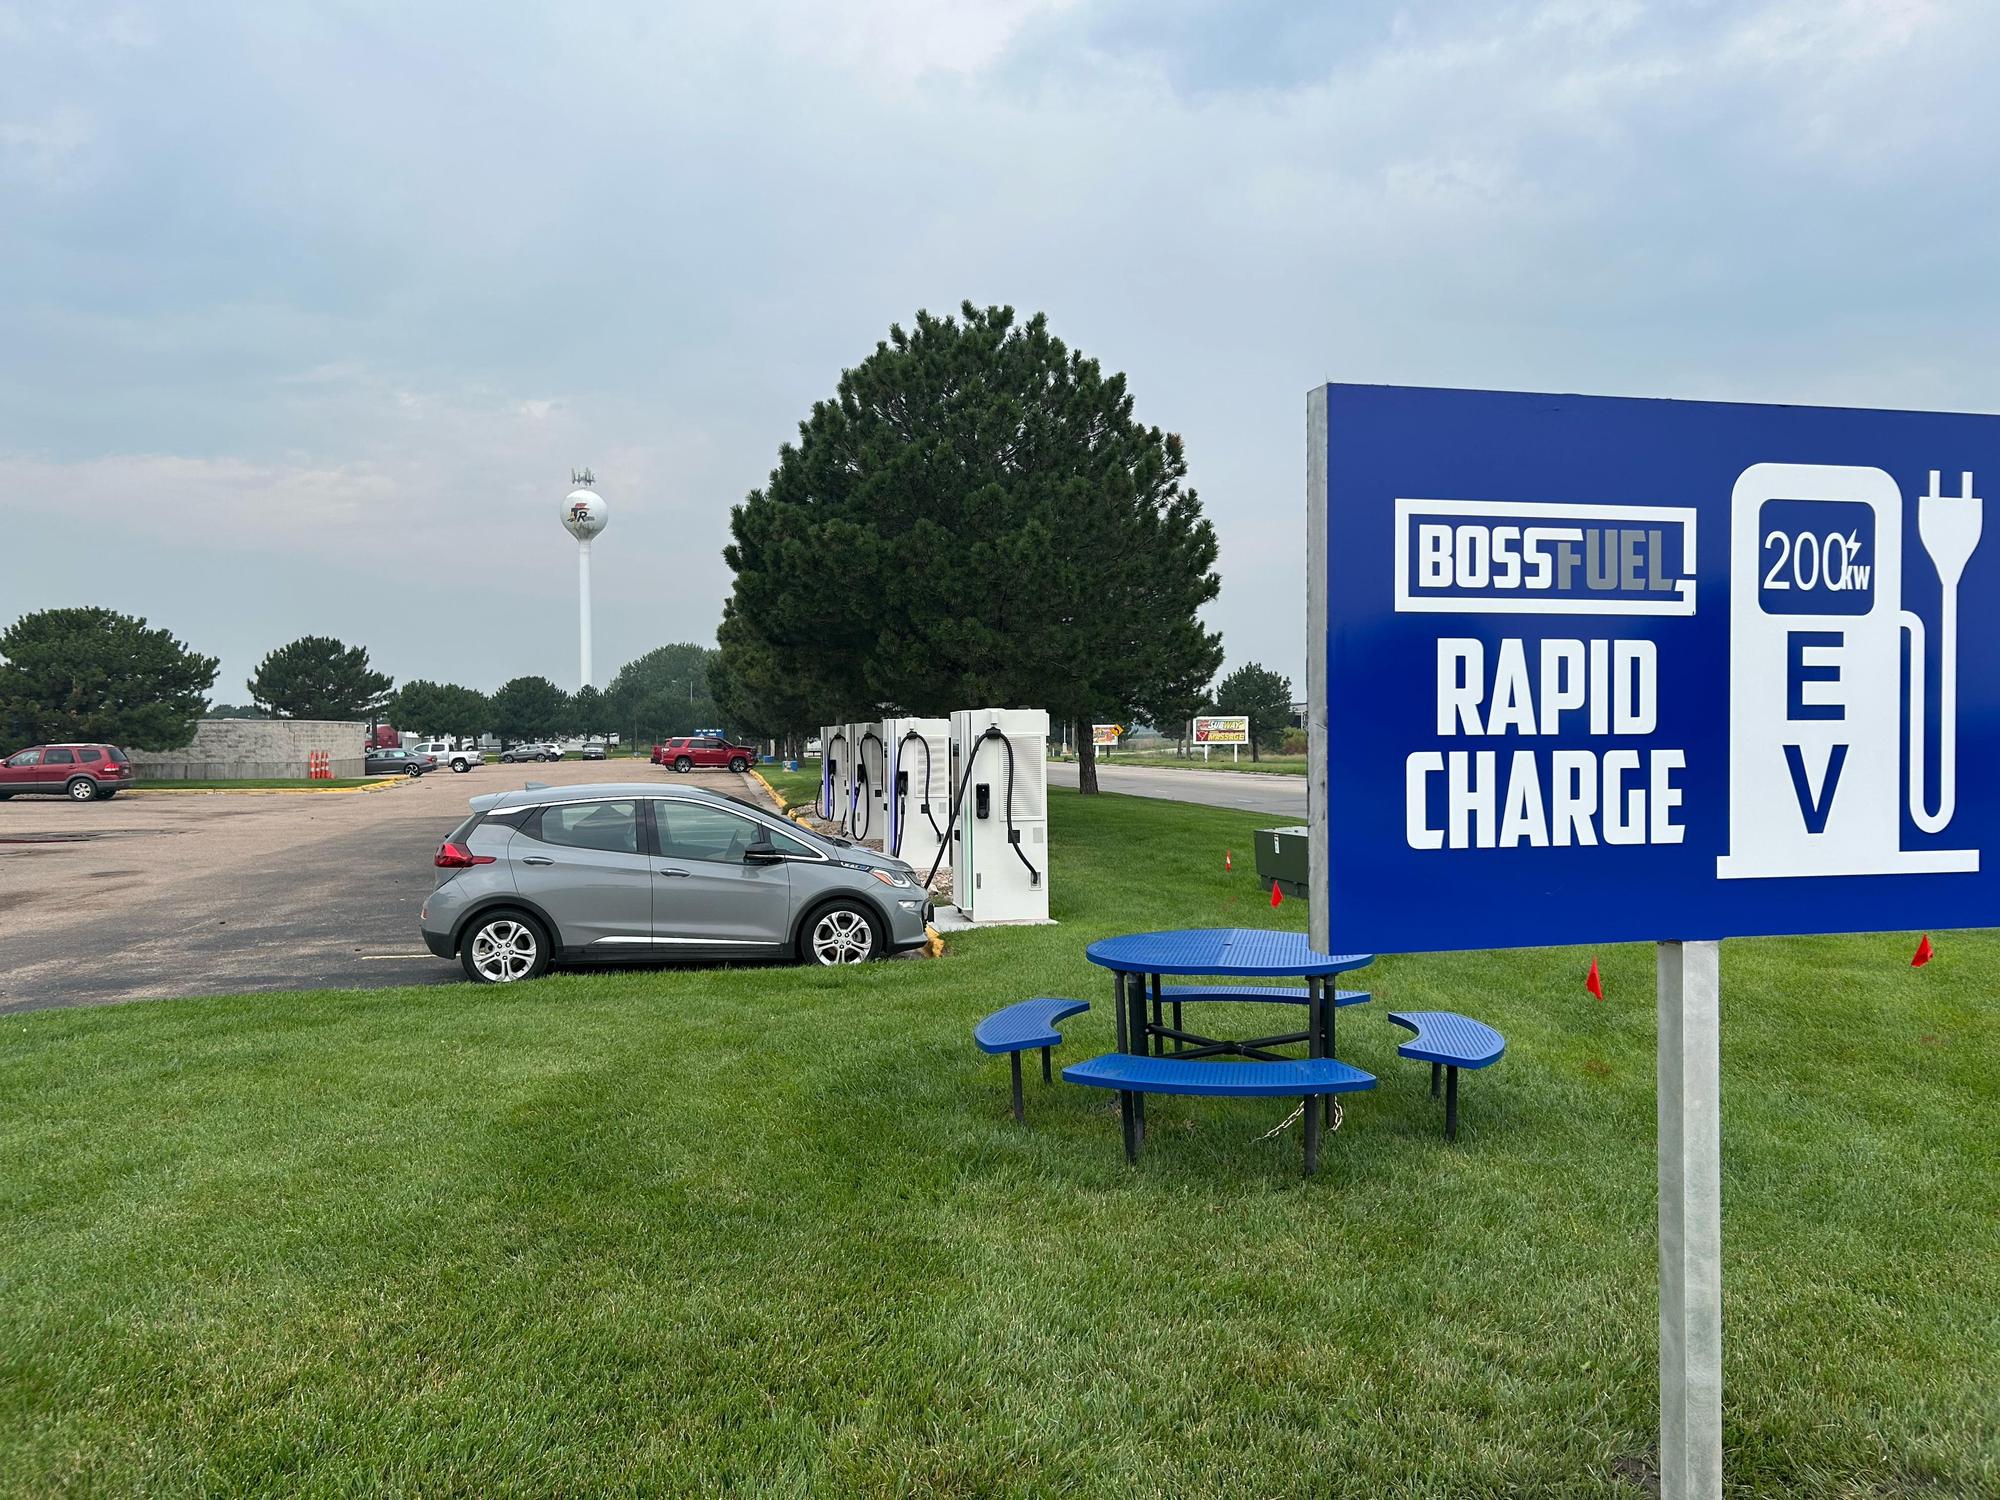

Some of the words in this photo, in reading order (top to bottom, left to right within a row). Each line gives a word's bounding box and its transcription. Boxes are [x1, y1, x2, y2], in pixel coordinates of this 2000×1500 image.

[1208, 721, 1244, 730] SUBWAY
[1437, 637, 1657, 736] RAPID
[1406, 749, 1687, 850] CHARGE
